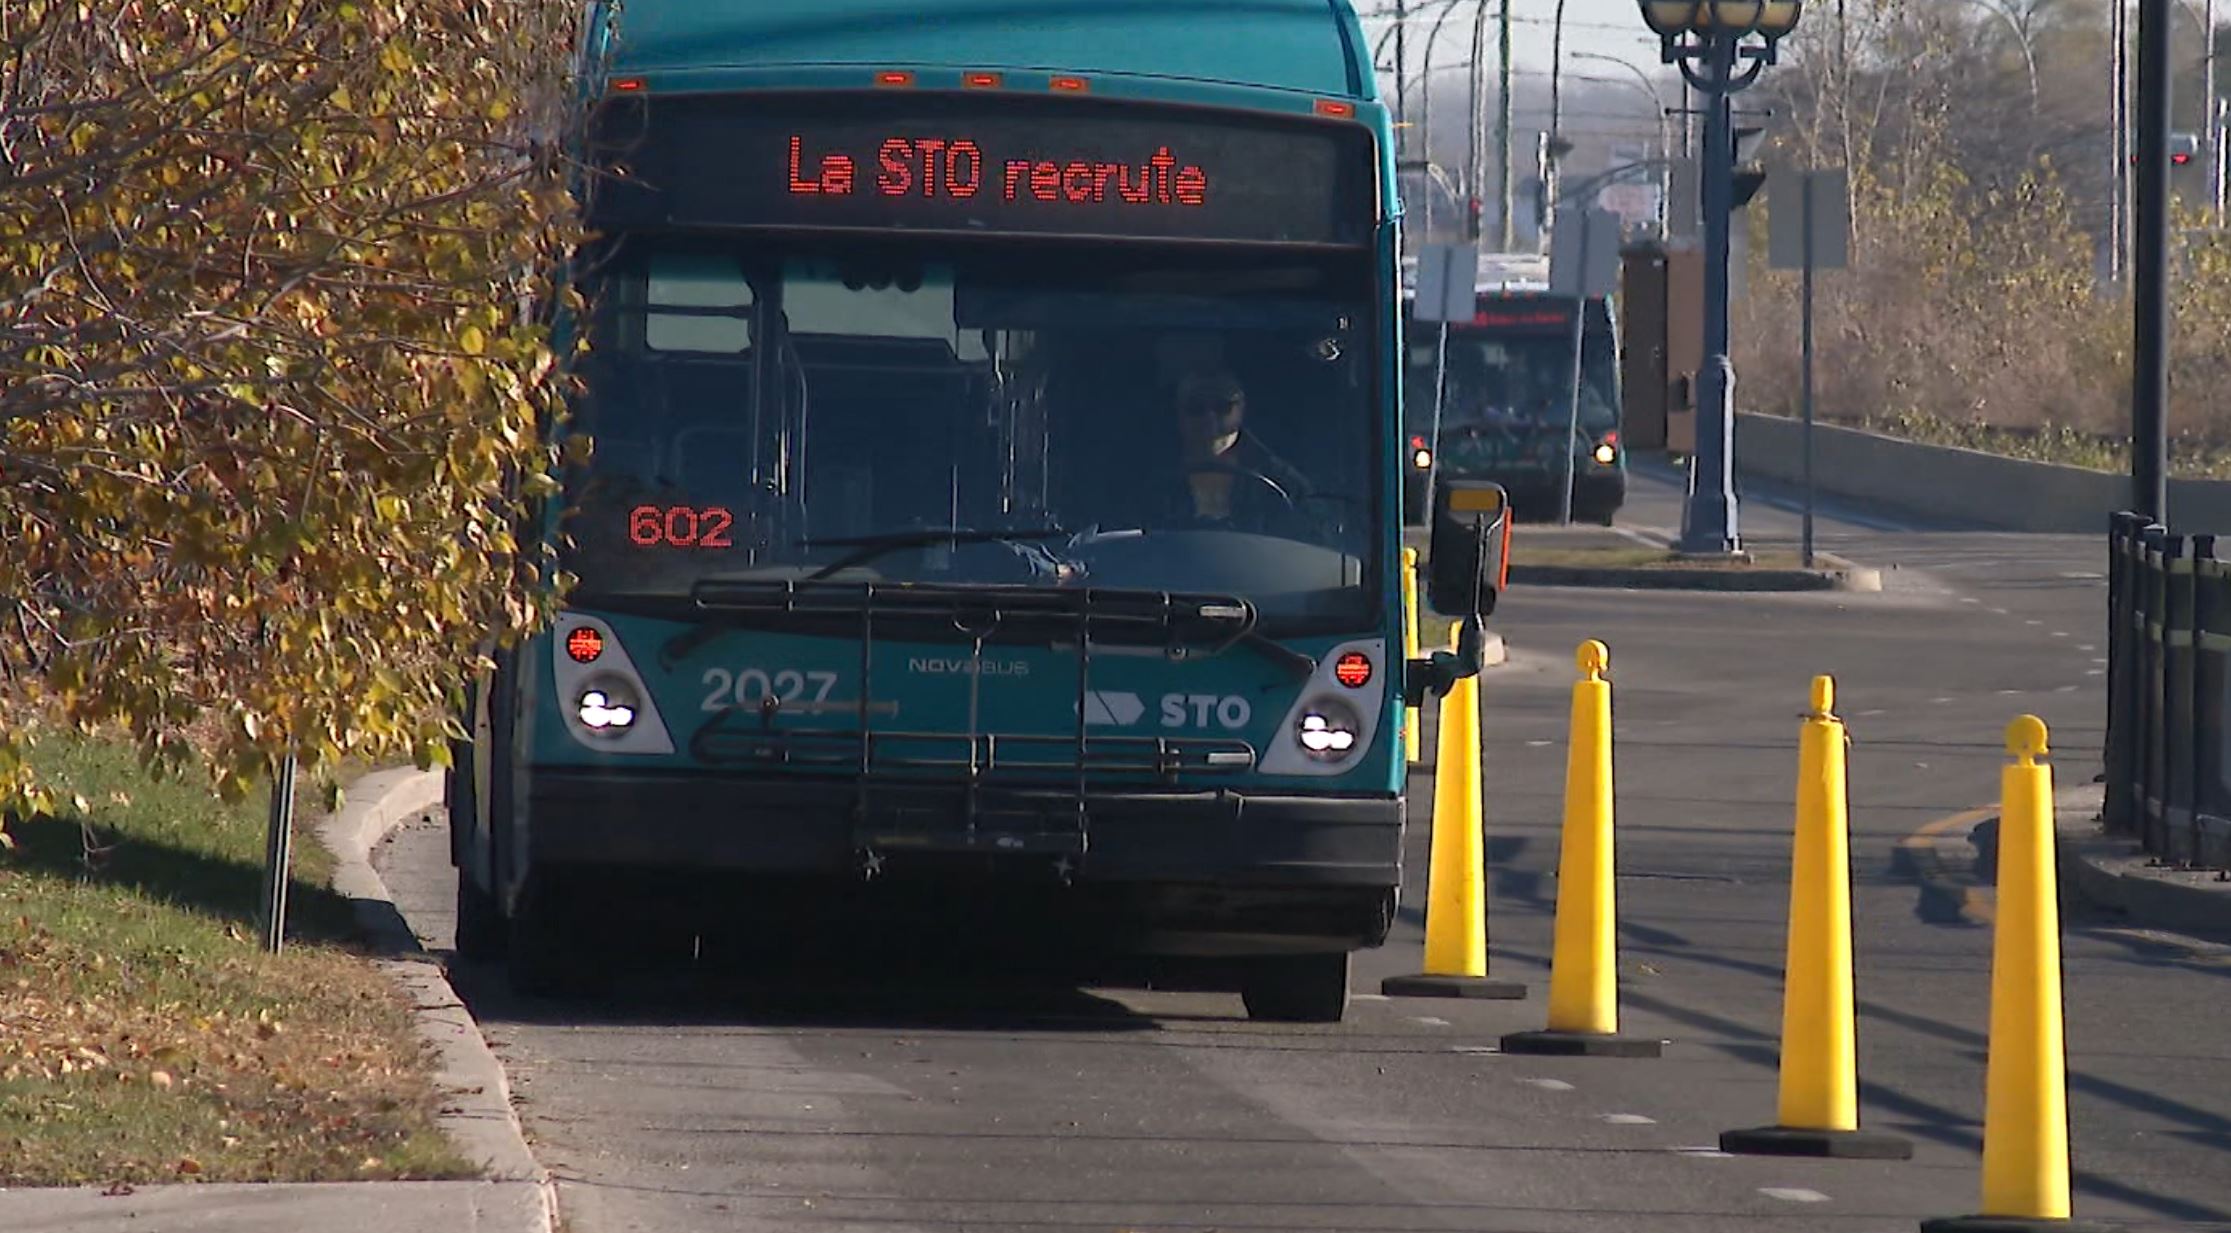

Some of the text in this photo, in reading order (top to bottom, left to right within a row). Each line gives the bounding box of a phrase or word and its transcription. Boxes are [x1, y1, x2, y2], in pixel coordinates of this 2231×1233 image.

[788, 136, 1206, 204] La STO recrute
[629, 506, 733, 547] 602
[701, 667, 837, 713] 2027
[1161, 694, 1251, 728] STO
